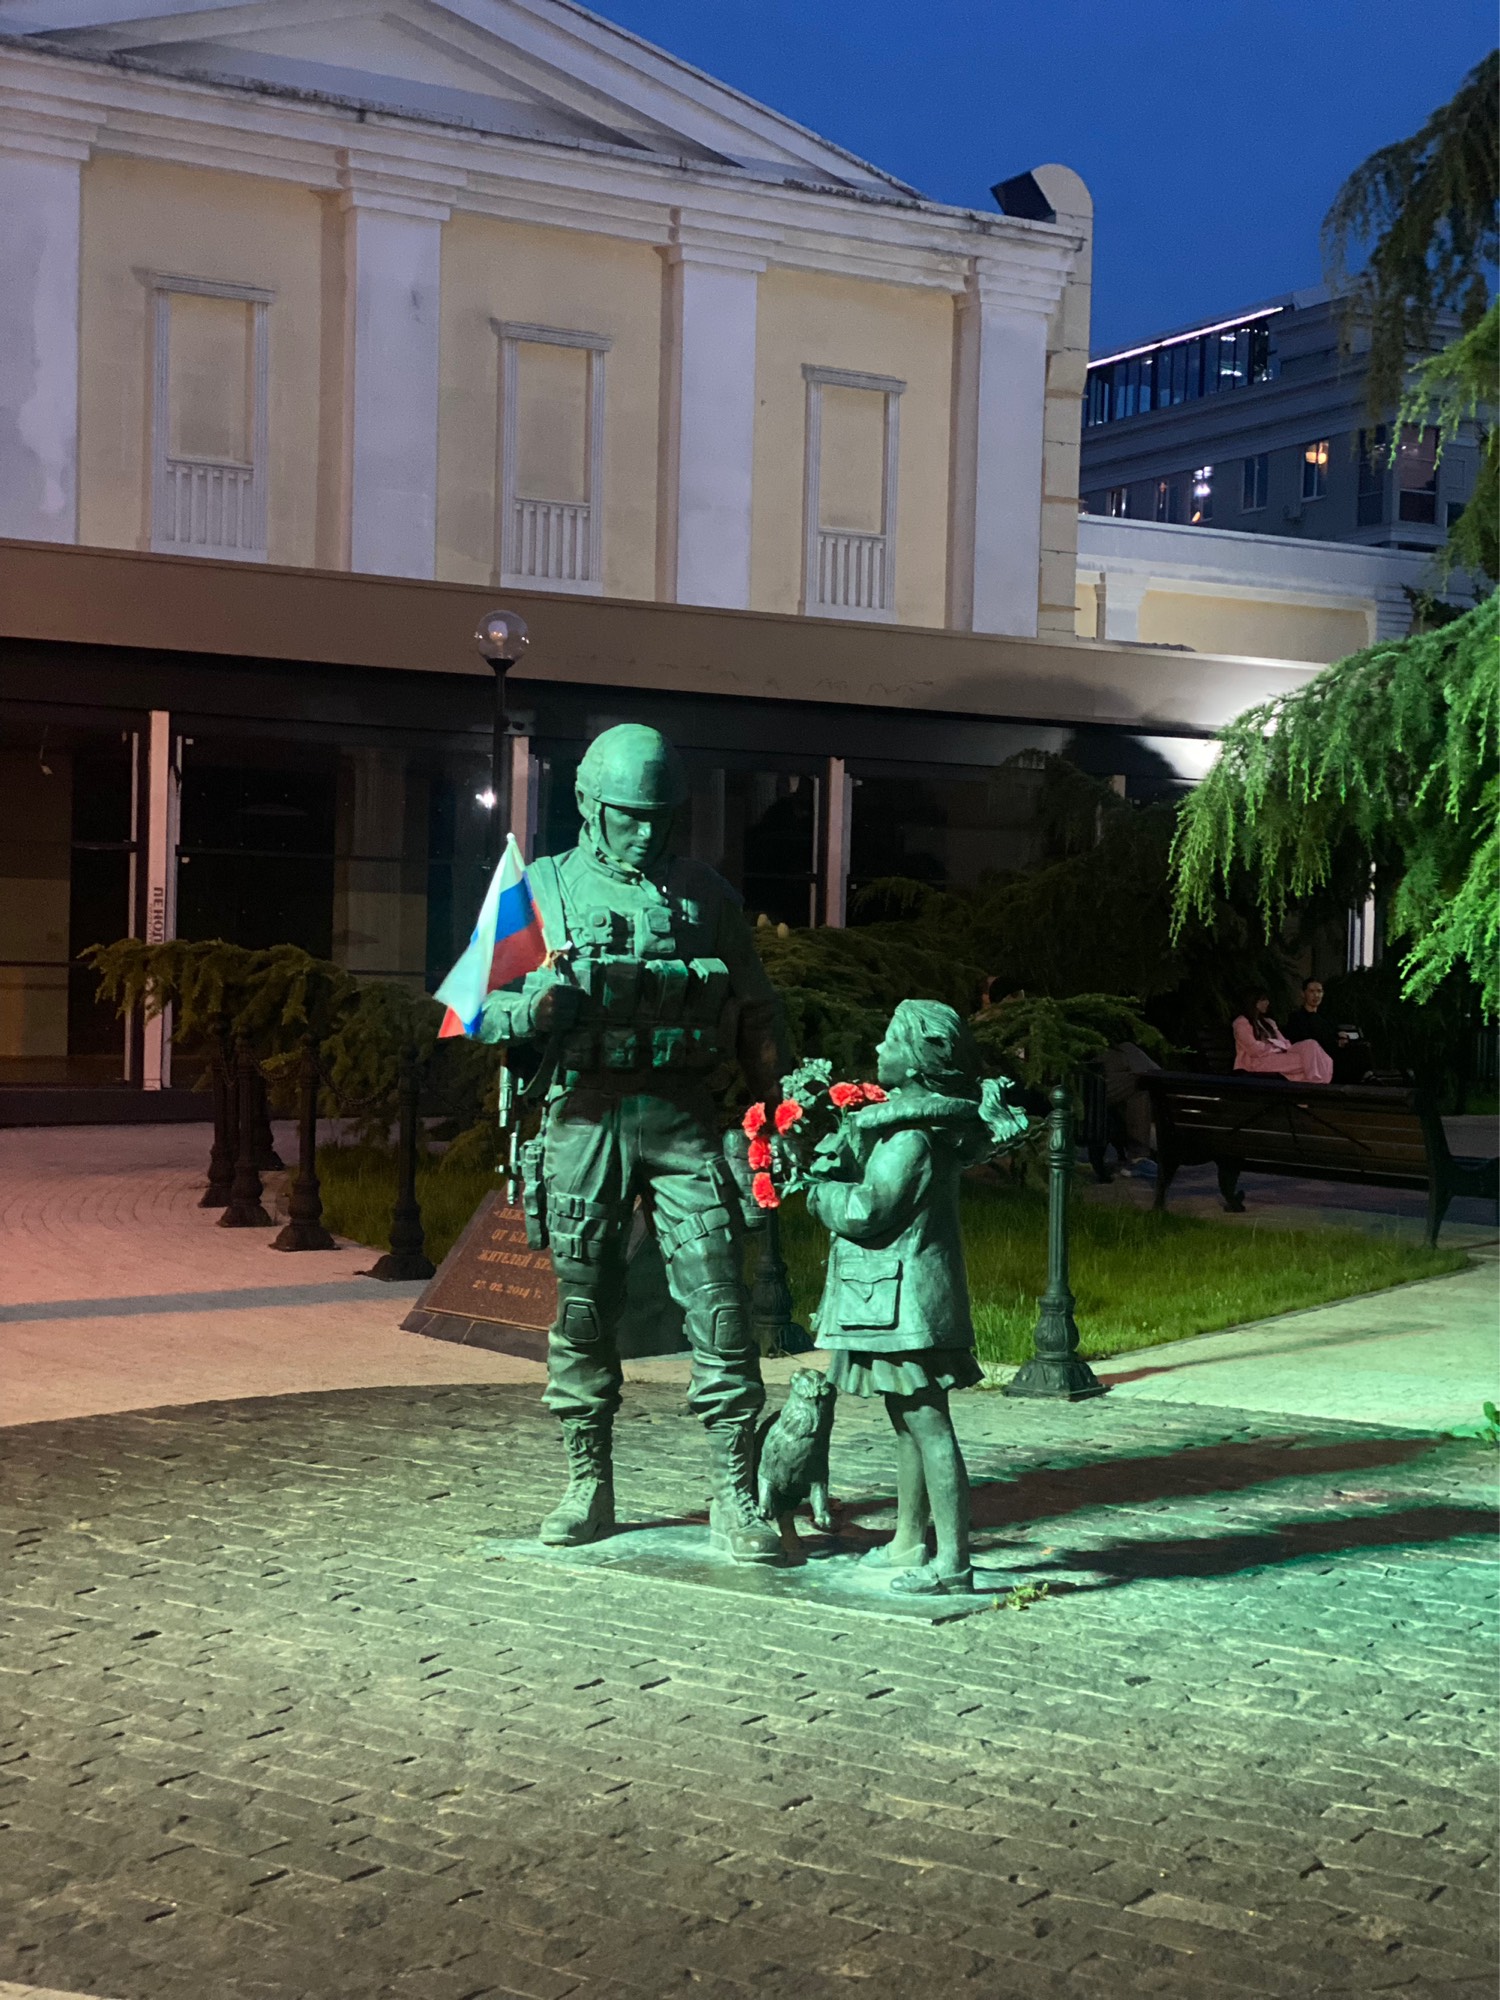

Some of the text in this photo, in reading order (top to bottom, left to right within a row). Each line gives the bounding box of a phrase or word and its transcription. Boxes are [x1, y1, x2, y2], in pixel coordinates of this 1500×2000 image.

[493, 1207, 525, 1221] «ВЕЖ
[491, 1229, 508, 1241] ОТ
[478, 1249, 532, 1268] ЖИТЕЛЕЙ
